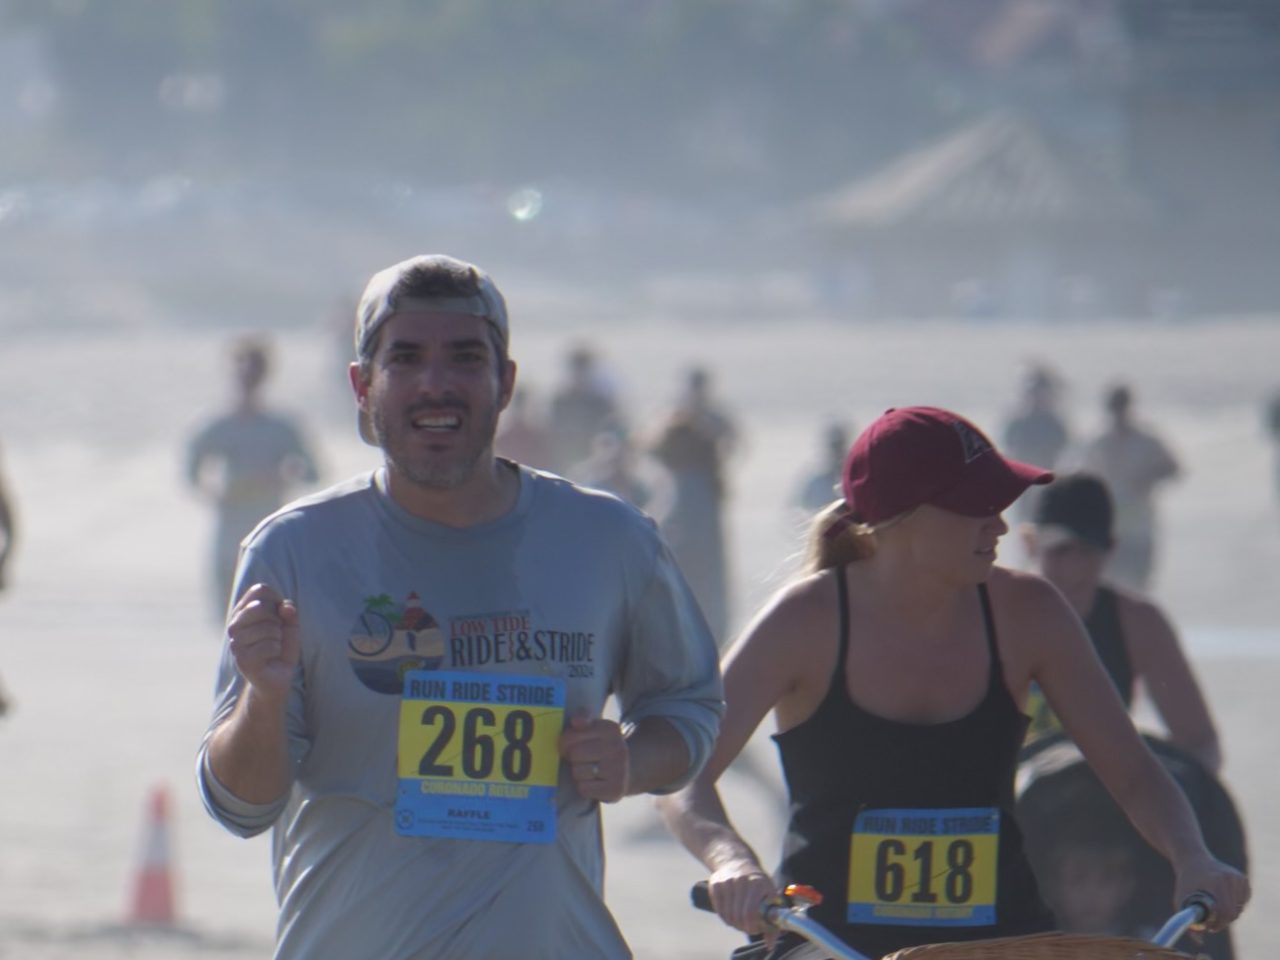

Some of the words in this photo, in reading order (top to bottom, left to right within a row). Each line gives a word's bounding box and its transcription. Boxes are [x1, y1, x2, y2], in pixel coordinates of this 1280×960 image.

[450, 619, 487, 637] LOW
[492, 615, 531, 633] TIDE
[410, 679, 445, 699] RUN
[452, 681, 491, 702] RIDE
[497, 684, 555, 705] STRIDE
[418, 705, 535, 782] 268
[875, 838, 975, 904] 618
